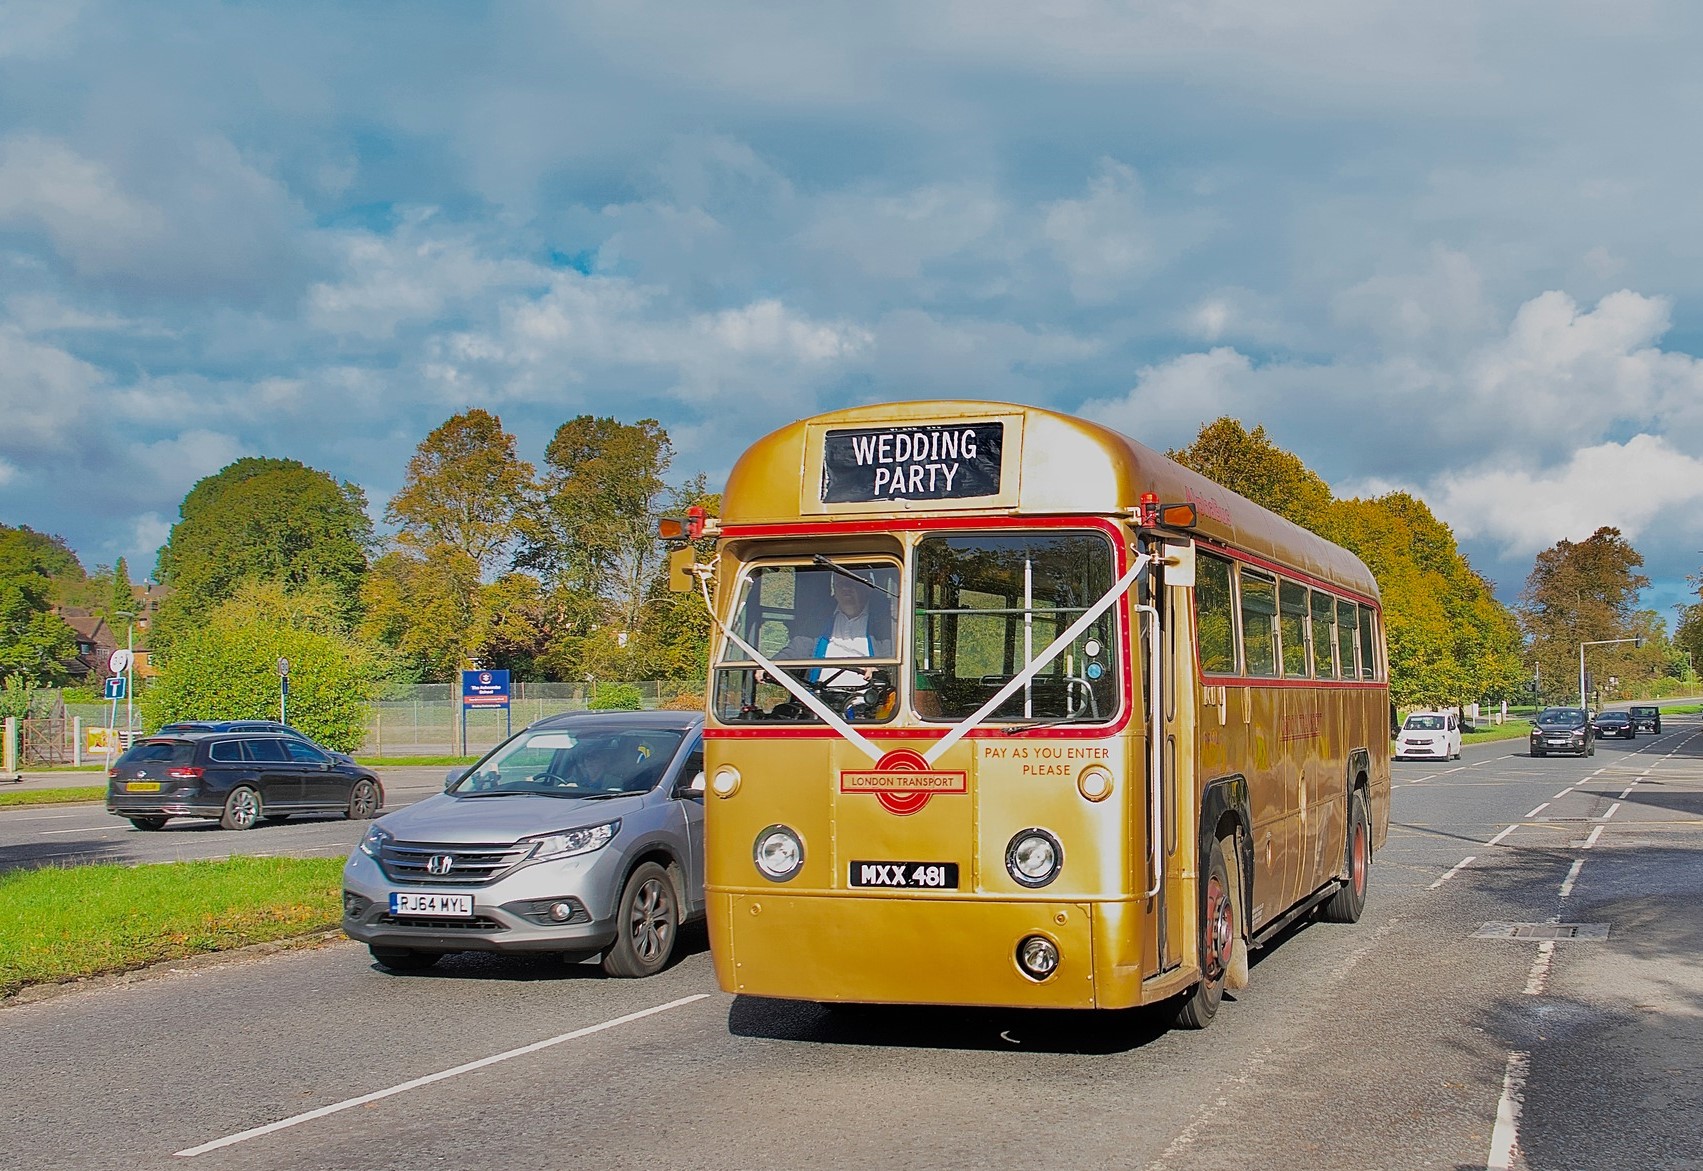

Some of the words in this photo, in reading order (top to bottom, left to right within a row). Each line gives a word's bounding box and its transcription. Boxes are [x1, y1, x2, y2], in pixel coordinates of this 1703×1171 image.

[852, 429, 977, 466] WEDDING
[874, 463, 959, 496] PARTY
[985, 747, 1007, 759] PAY
[1012, 747, 1028, 759] AS
[1033, 747, 1062, 759] YOU
[1067, 747, 1110, 759] ENTER
[1023, 764, 1071, 776] PLEASE
[851, 777, 894, 787] LONDON
[896, 777, 954, 787] TRANSPORT
[861, 864, 907, 886] MXX
[912, 865, 945, 887] 481
[400, 896, 436, 912] RJ64
[440, 897, 468, 913] MYL
